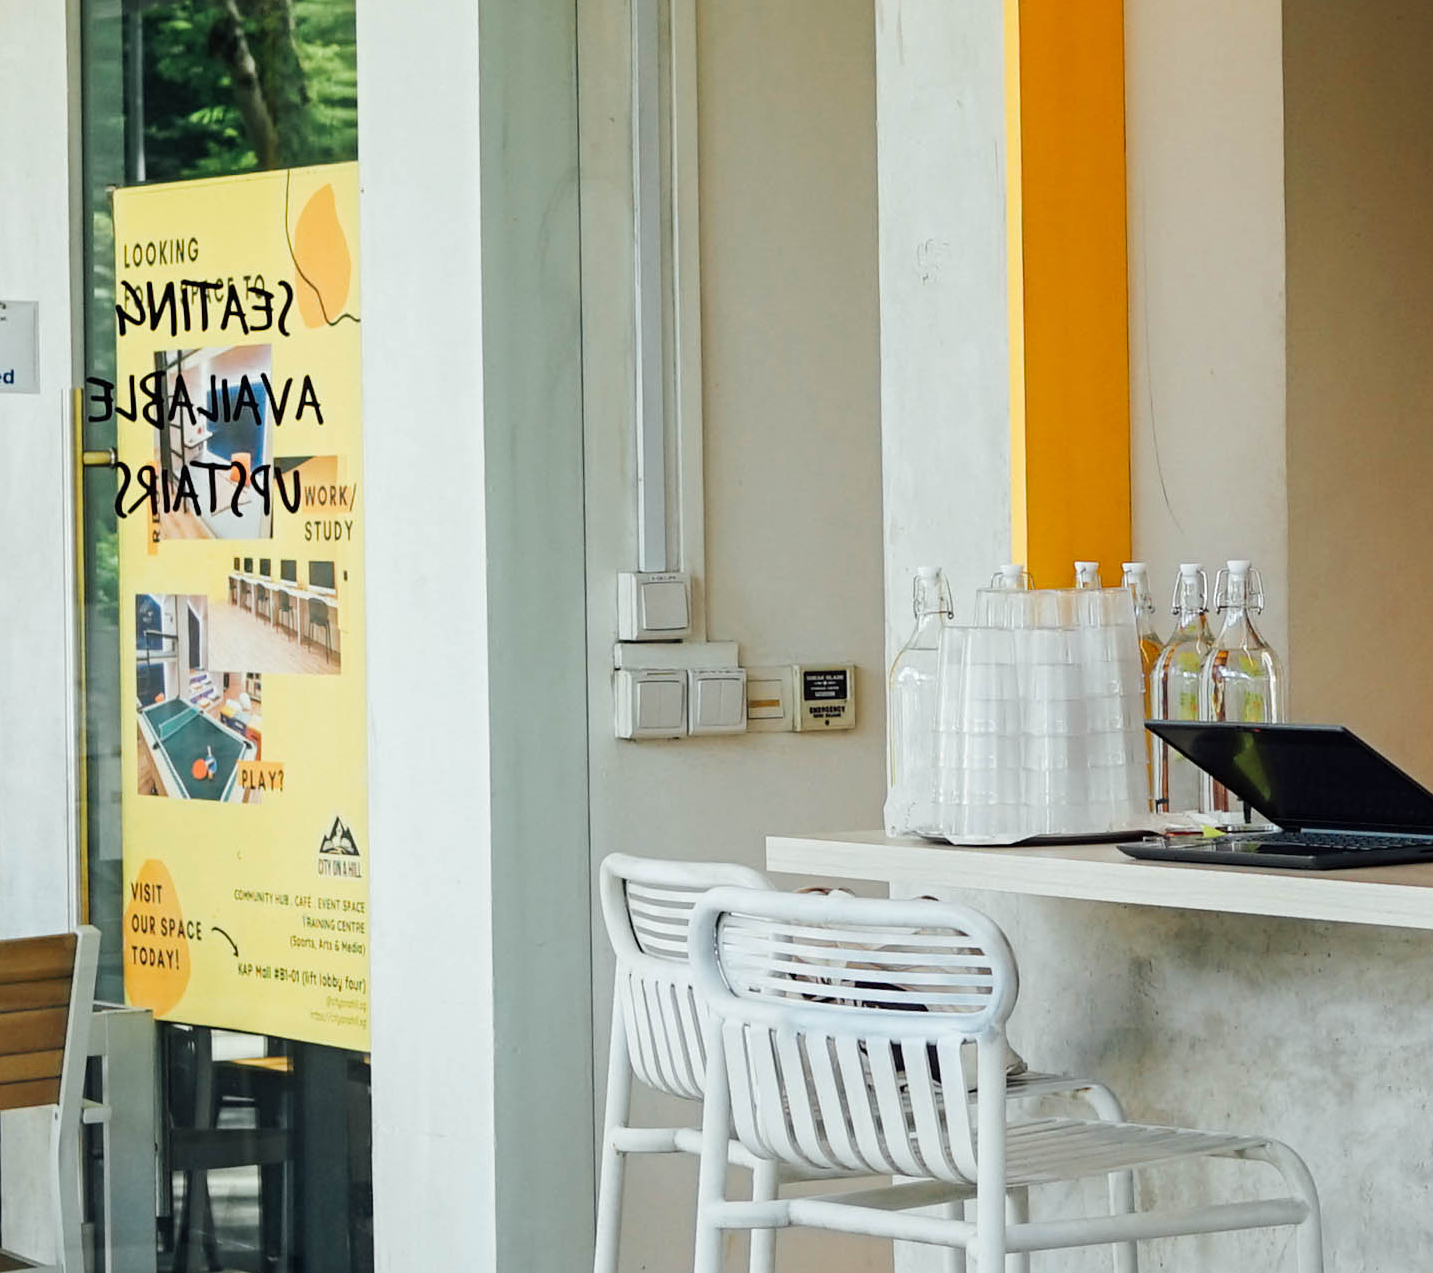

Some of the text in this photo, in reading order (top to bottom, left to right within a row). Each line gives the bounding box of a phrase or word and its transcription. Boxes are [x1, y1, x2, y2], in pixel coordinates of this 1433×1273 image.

[124, 237, 200, 268] LOOKING
[304, 483, 357, 513] WORK/
[304, 520, 354, 543] STUDY
[241, 767, 285, 793] PLAY?
[131, 882, 162, 904] VISIT
[234, 889, 275, 904] COMMUNITY
[275, 895, 289, 906] HUB
[318, 897, 340, 911] EVENT
[343, 901, 365, 914] SPACE
[131, 913, 202, 941] OUR SPACE
[303, 915, 365, 934] TRAINING CENTRE
[131, 945, 180, 970] TODAY!
